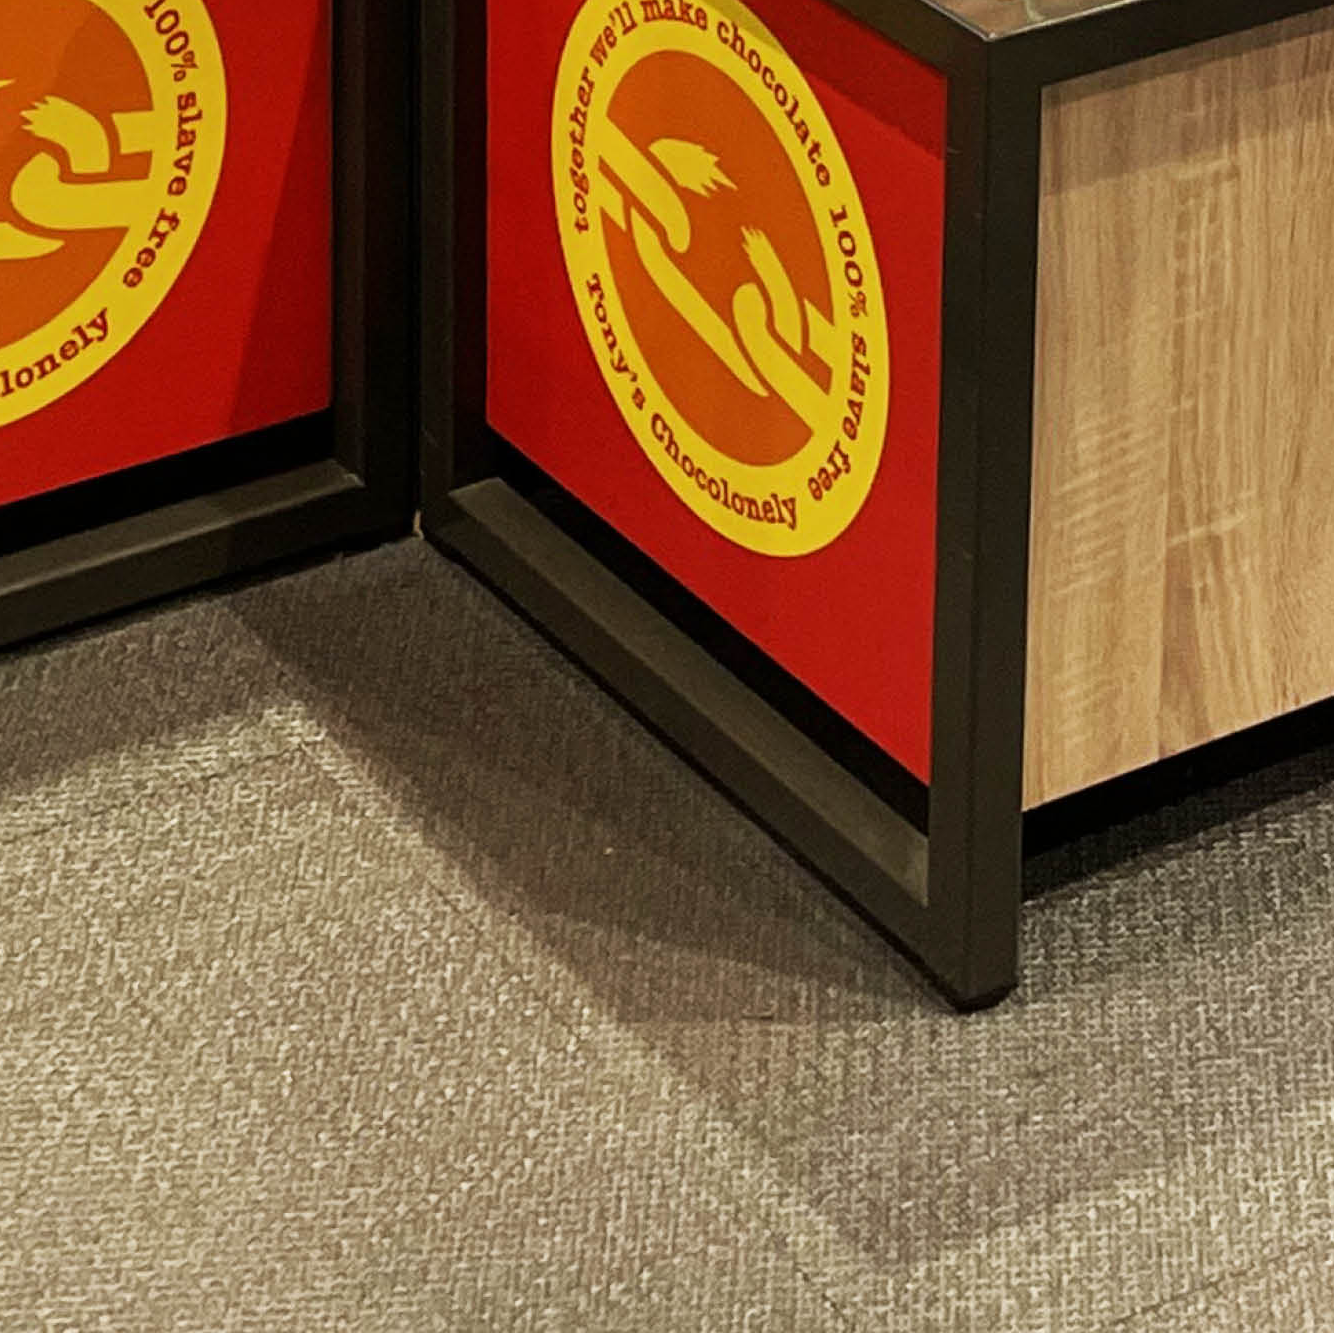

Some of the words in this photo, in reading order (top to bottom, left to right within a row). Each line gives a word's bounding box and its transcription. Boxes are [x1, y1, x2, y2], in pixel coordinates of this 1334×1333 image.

[589, 1, 638, 68] we'll
[168, 91, 203, 197] slave
[569, 66, 597, 235] together
[717, 19, 831, 188] chocolate
[122, 207, 181, 289] free
[829, 204, 869, 318] 100%
[586, 271, 646, 411] Tony's
[650, 412, 798, 531] Chocolonely
[842, 331, 871, 441] slave
[807, 440, 852, 502] free
